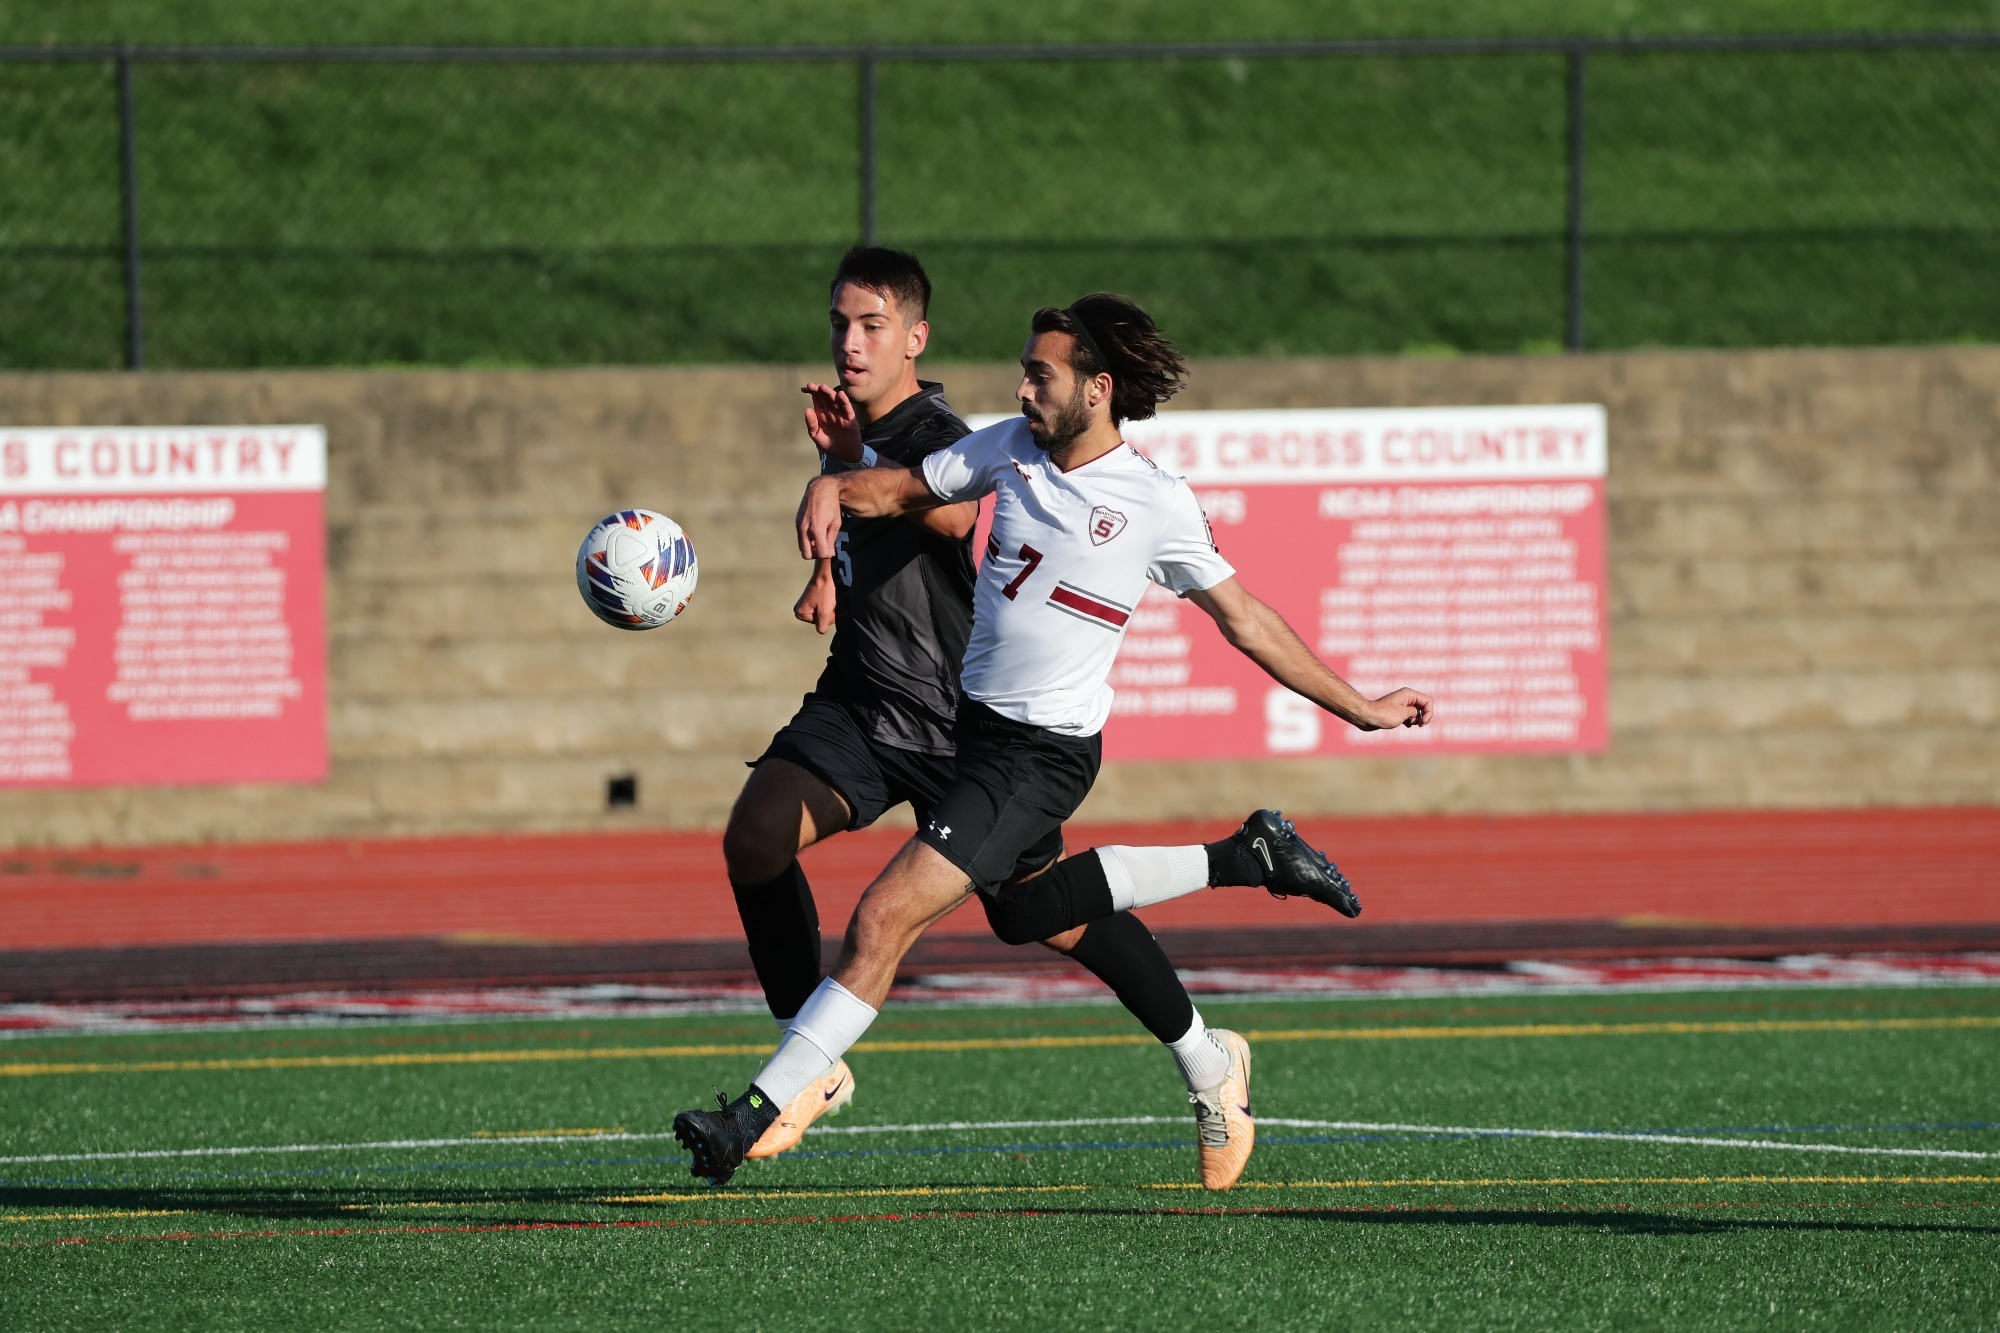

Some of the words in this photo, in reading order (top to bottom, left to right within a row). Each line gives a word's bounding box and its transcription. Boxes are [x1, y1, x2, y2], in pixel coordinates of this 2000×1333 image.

[54, 434, 298, 476] COUNTRY
[1216, 429, 1363, 467] CROSS
[1383, 426, 1590, 467] COUNTRY
[1093, 519, 1115, 539] S
[1001, 543, 1044, 602] 7
